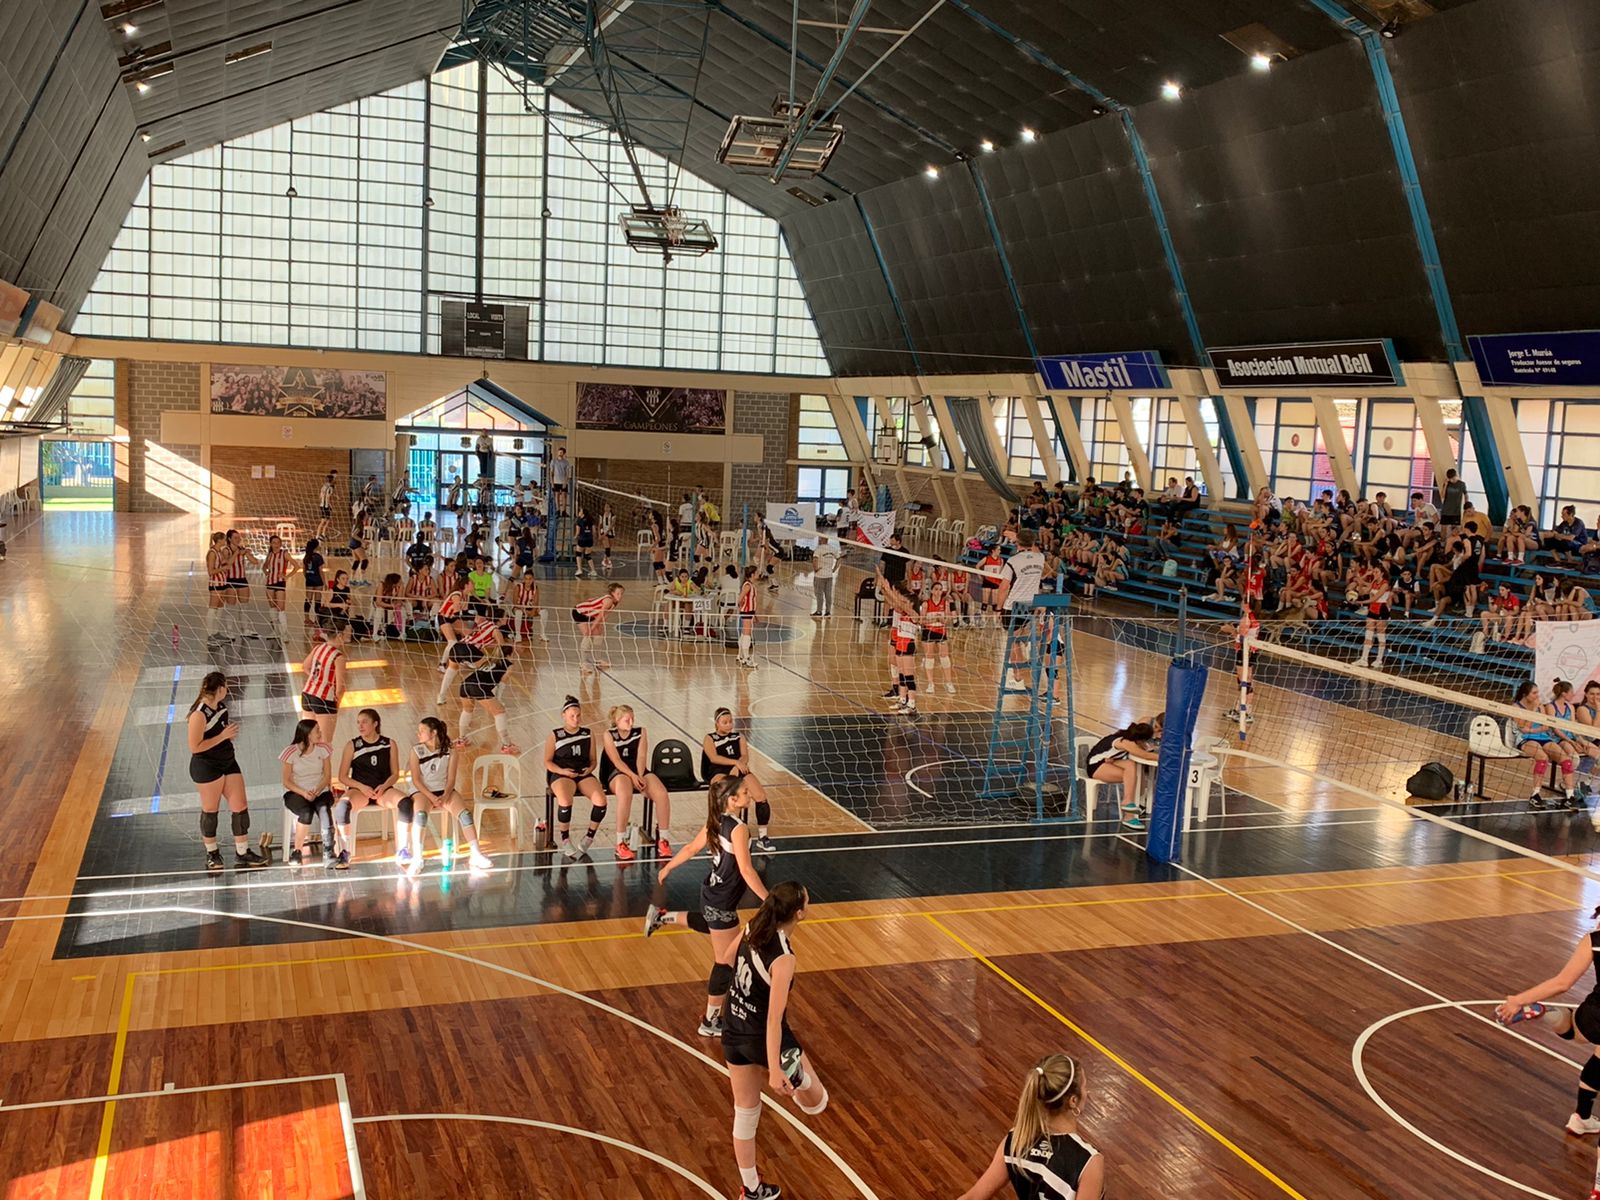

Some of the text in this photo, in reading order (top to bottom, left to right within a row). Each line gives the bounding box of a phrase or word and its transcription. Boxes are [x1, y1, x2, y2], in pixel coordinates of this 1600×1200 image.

[1507, 349, 1524, 358] Jorge
[1227, 353, 1373, 376] Asociación Mutual Bell
[1059, 357, 1133, 387] Mastil
[623, 421, 678, 432] CAMPEONES
[370, 754, 378, 766] 8
[1191, 770, 1199, 783] 3
